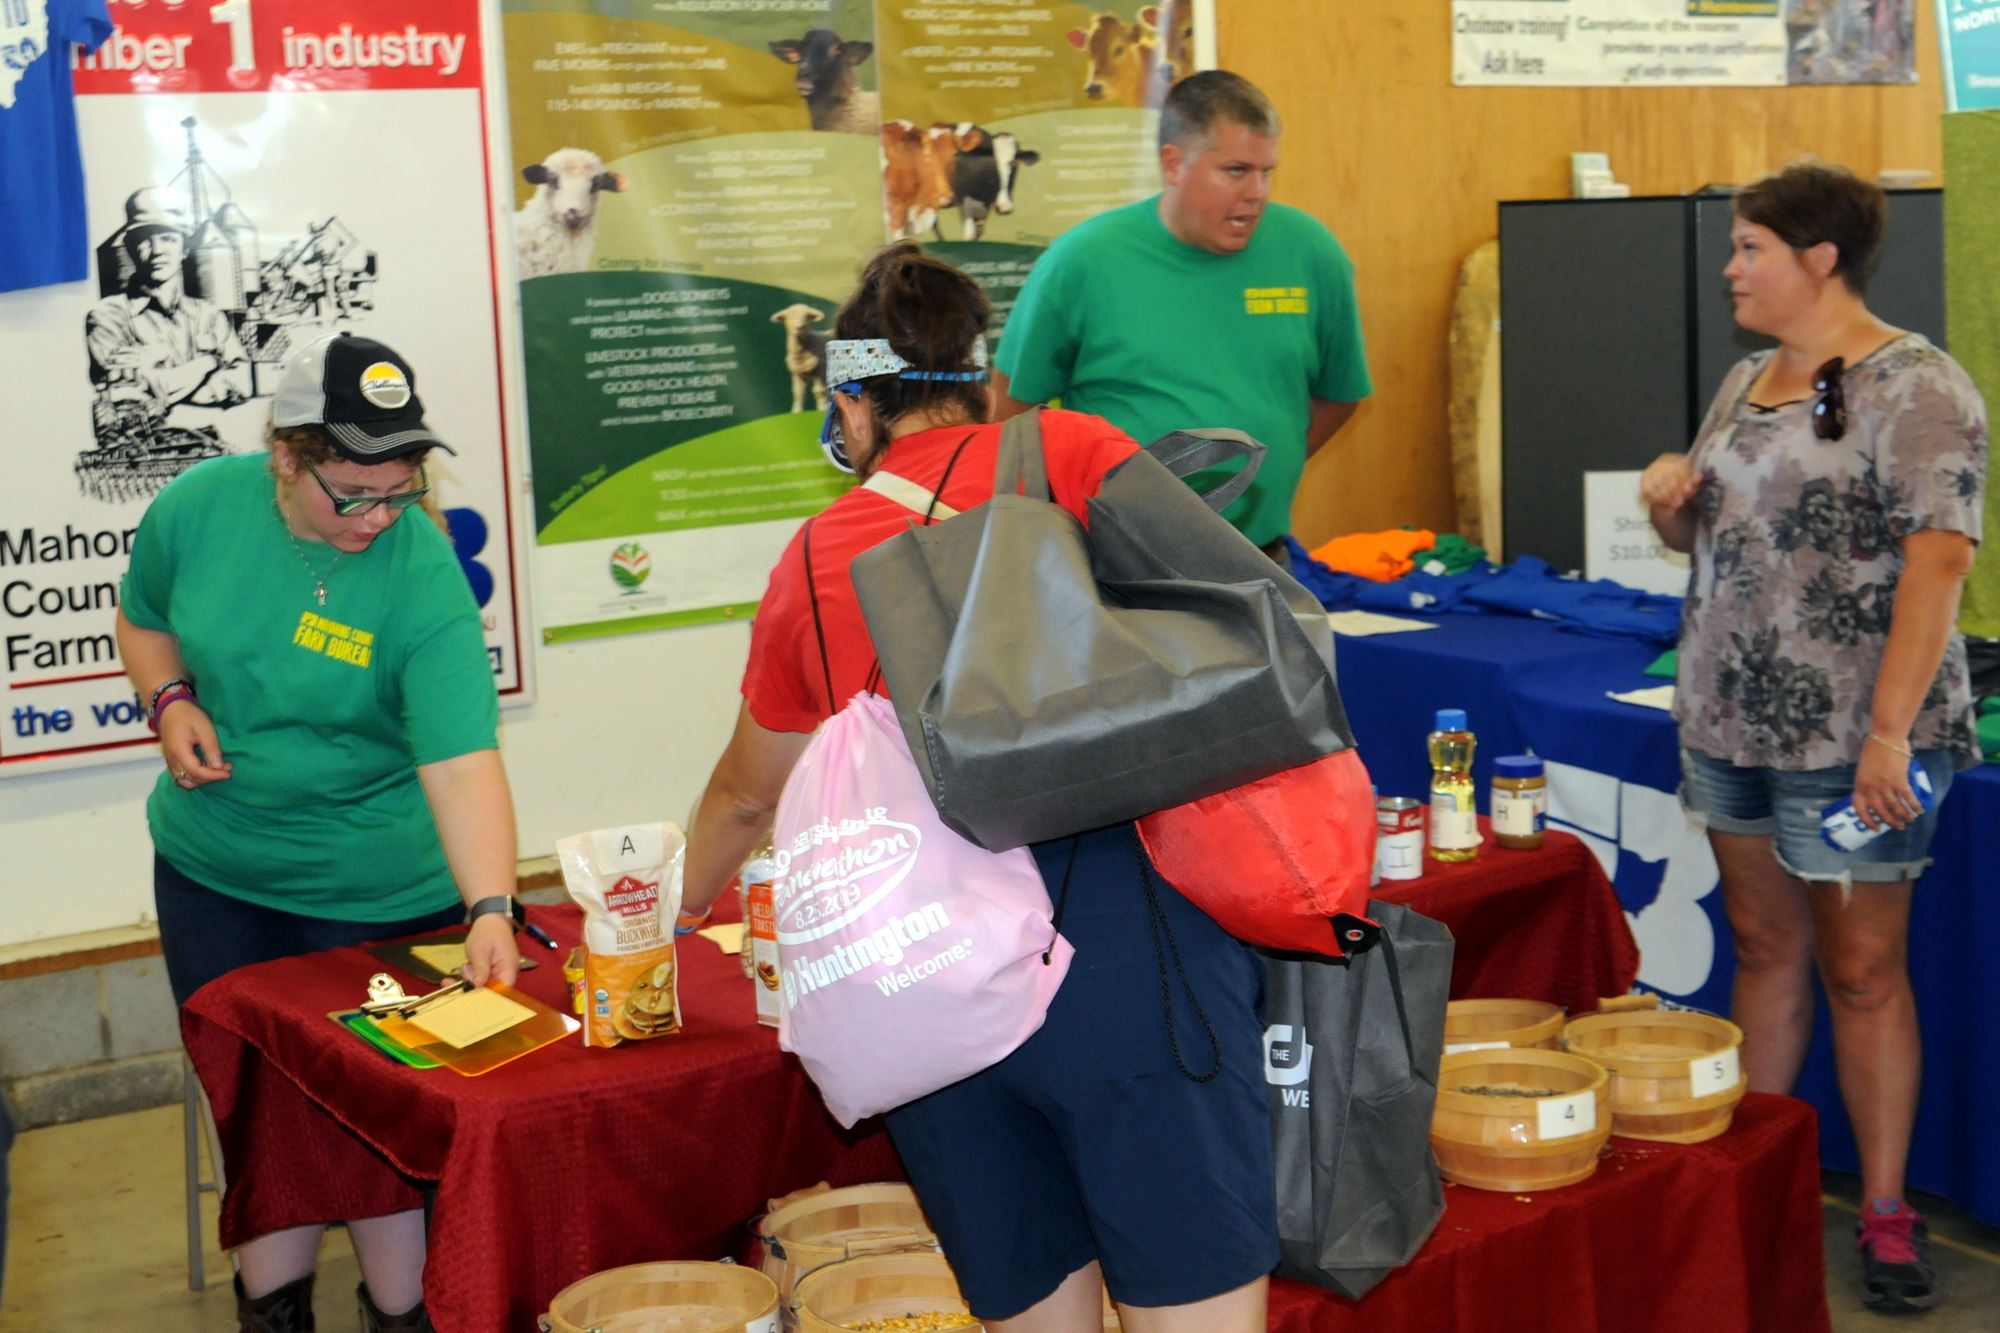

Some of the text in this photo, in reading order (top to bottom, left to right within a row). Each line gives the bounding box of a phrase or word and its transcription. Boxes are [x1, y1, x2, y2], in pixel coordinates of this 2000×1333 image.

[211, 0, 254, 71] 1
[283, 26, 465, 75] industry
[1481, 49, 1545, 75] Ask here
[3, 576, 124, 618] Coun
[7, 633, 115, 671] Farm
[12, 704, 73, 737] the
[621, 835, 636, 856] A
[608, 884, 657, 908] ARROWHEAD
[622, 902, 648, 914] MILLS
[793, 900, 951, 995] Huntington
[1272, 1048, 1290, 1061] THE
[1714, 1062, 1725, 1079] 5
[1281, 1088, 1310, 1108] WE
[1565, 1104, 1576, 1122] 4
